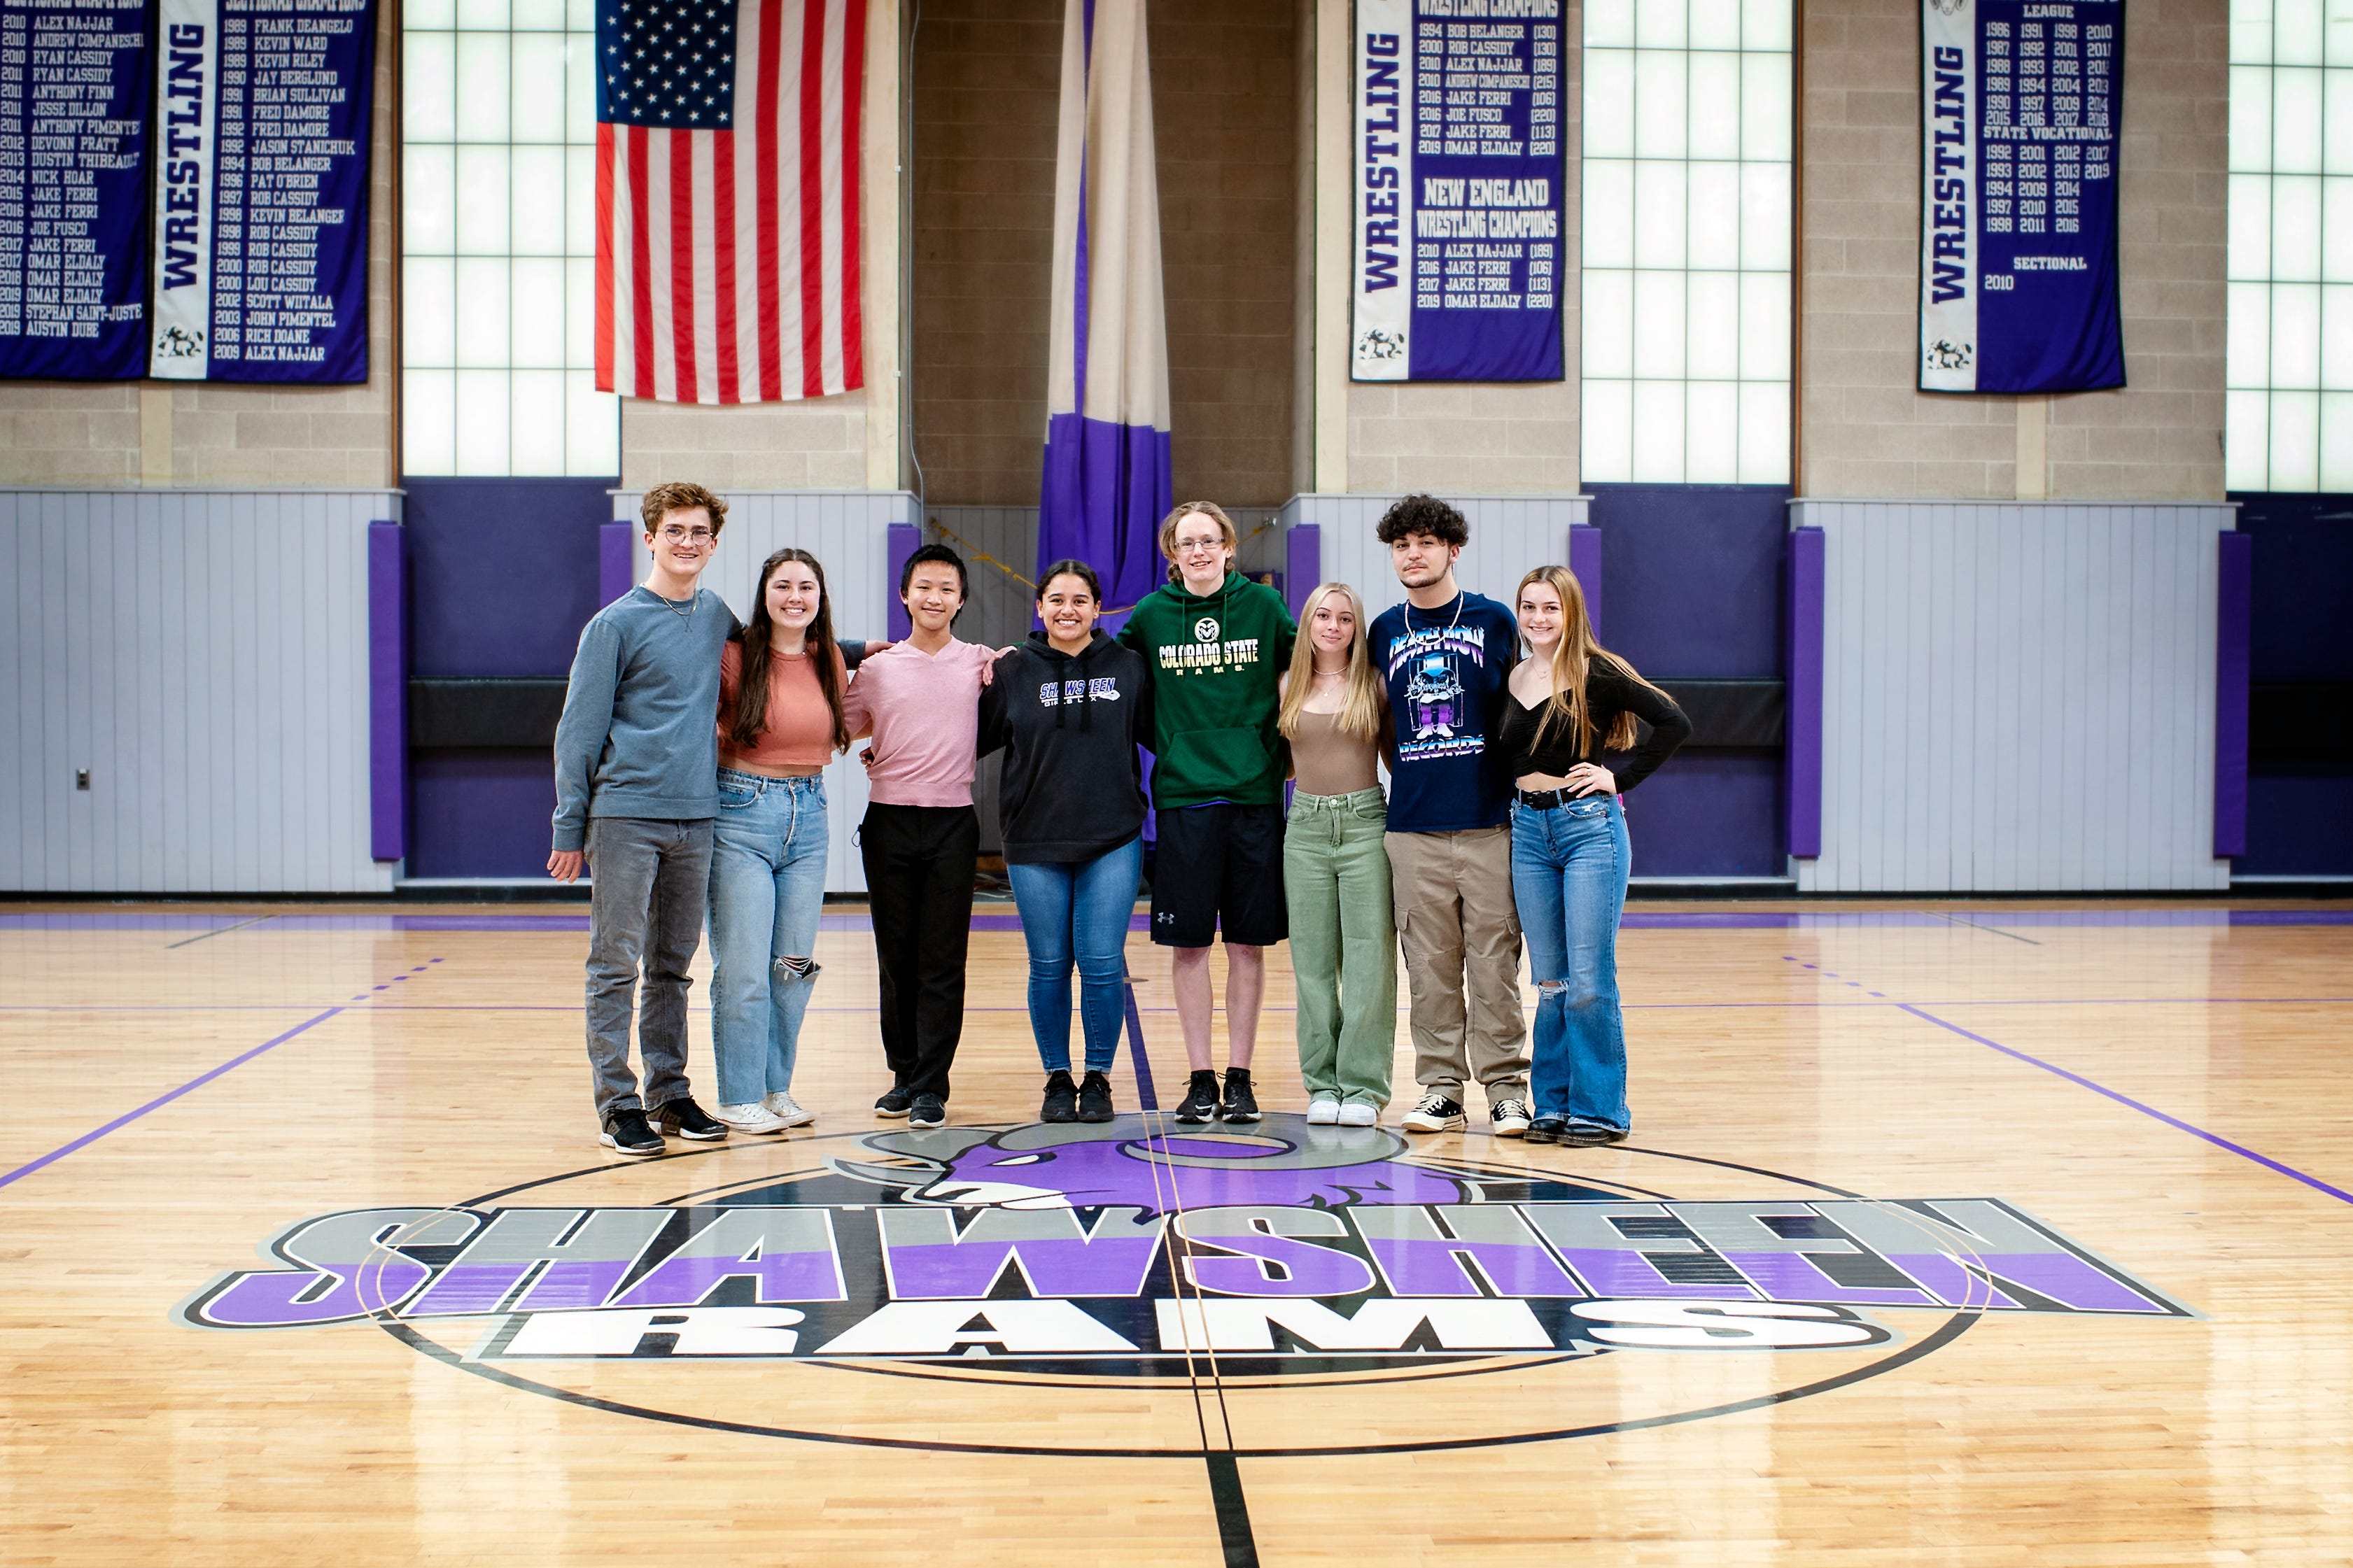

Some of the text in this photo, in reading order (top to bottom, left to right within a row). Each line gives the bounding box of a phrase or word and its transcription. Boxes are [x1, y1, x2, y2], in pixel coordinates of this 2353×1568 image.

[2023, 5, 2074, 18] LEAGUE
[3, 15, 113, 31] 2010 ALEX NAJJAR
[224, 20, 353, 33] 1989 FRANK DEANGELO
[1419, 24, 1556, 39] 1994 BOB BELANGER (130)
[2021, 24, 2043, 38] 1991
[2086, 25, 2112, 40] 2010
[224, 37, 328, 50] 1989 KEVIN WARD
[1419, 41, 1556, 56] 2000 ROB CASSIDY (130)
[1986, 41, 2009, 55] 1987
[2020, 42, 2044, 56] 1992
[2054, 42, 2077, 57] 2001
[2, 50, 113, 65] 2010 RYAN CASSIDY
[224, 54, 325, 68] 1989 KEVIN RILEY
[1419, 57, 1440, 69] 2010
[1446, 58, 1475, 71] ALEX
[1478, 59, 1522, 71] NAJJAR
[2019, 60, 2044, 74] 1993
[2053, 60, 2079, 75] 2002
[2018, 78, 2045, 92] 1994
[2052, 78, 2080, 93] 2004
[223, 88, 345, 102] 1991 BRIAN SULLIVAN
[1419, 91, 1441, 104] 2016
[1446, 92, 1475, 104] JAKE
[1479, 92, 1511, 105] FERRI
[1, 102, 106, 117] 2011 JESSE DILLON
[1986, 95, 2080, 111] 1990 1997 2009
[1419, 108, 1555, 123] 2016 JOE FUSCO (220)
[1986, 111, 2079, 127] 2015 2016 2017
[1420, 125, 1555, 139] 2017 JAKE FERRI (113)
[1983, 127, 2112, 139] STATE VOCATIONAL
[0, 136, 119, 151] 2012 DEVONN PRATT
[220, 140, 355, 155] 1992 JASON STANICHUK
[1419, 141, 1555, 156] 2019 OMAR ELDALY (220)
[164, 24, 204, 290] WRESTLING
[1986, 145, 2109, 161] 1992 2001 2012 2017
[220, 157, 331, 171] 1994 BOB BELANGER
[1365, 34, 1399, 292] WRESTLING
[0, 170, 94, 184] 2014 NICK HOAR
[1932, 46, 1965, 304] WRESTLING
[1986, 163, 2109, 179] 1993 2002 2013 2019
[1424, 178, 1548, 206] NEW ENGLAND
[1986, 181, 2079, 197] 1994 2009 2014
[1986, 199, 2079, 215] 1997 2010 2015
[0, 220, 87, 236] 2016 JOE FUSCO
[1417, 211, 1557, 238] WRESTLING CHAMPIONS
[1986, 218, 2079, 233] 1998 2011 2016
[1418, 244, 1439, 257] 2010
[1445, 245, 1473, 257] ALEX
[1476, 245, 1522, 257] NAJJAR
[1418, 261, 1552, 276] 2016 JAKE FERRI (106)
[2014, 257, 2087, 270] SECTIONAL
[1418, 278, 1551, 291] 2017 JAKE FERRI (113)
[1985, 275, 2014, 290] 2010
[216, 293, 240, 306] 2002
[246, 295, 281, 309] SCOTT
[1417, 295, 1552, 309] 2019 OMAR ELDALY (220)
[216, 311, 336, 327] 2003 JOHN PIMENTEL
[1159, 639, 1259, 668] COLORADO STATE
[1398, 735, 1485, 761] RECORDS
[196, 1201, 2175, 1326] SHAWSHEEN
[500, 1298, 1872, 1355] RAMS
